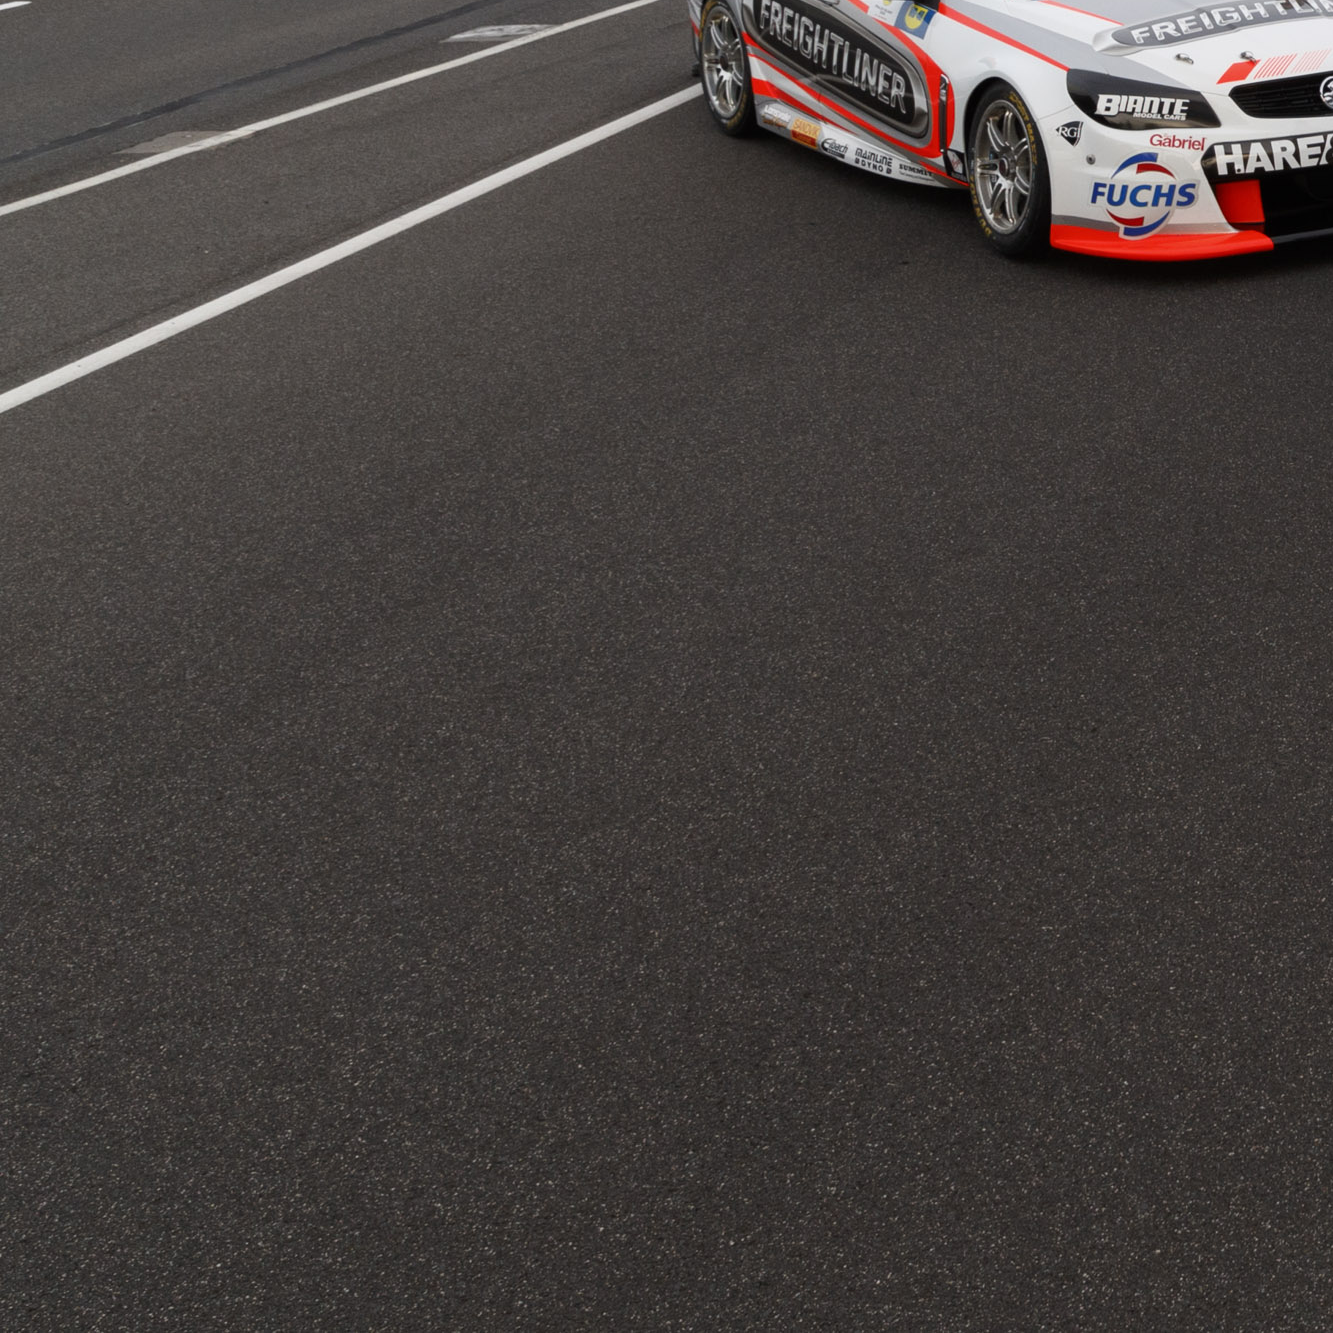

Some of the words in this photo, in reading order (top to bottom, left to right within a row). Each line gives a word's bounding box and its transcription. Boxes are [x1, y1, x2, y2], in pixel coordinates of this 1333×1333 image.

[1094, 93, 1191, 117] BIANTE
[1133, 112, 1163, 120] MODEL
[1163, 113, 1187, 121] CARS
[1150, 133, 1207, 151] Gabriel
[1090, 181, 1197, 208] FUCHS
